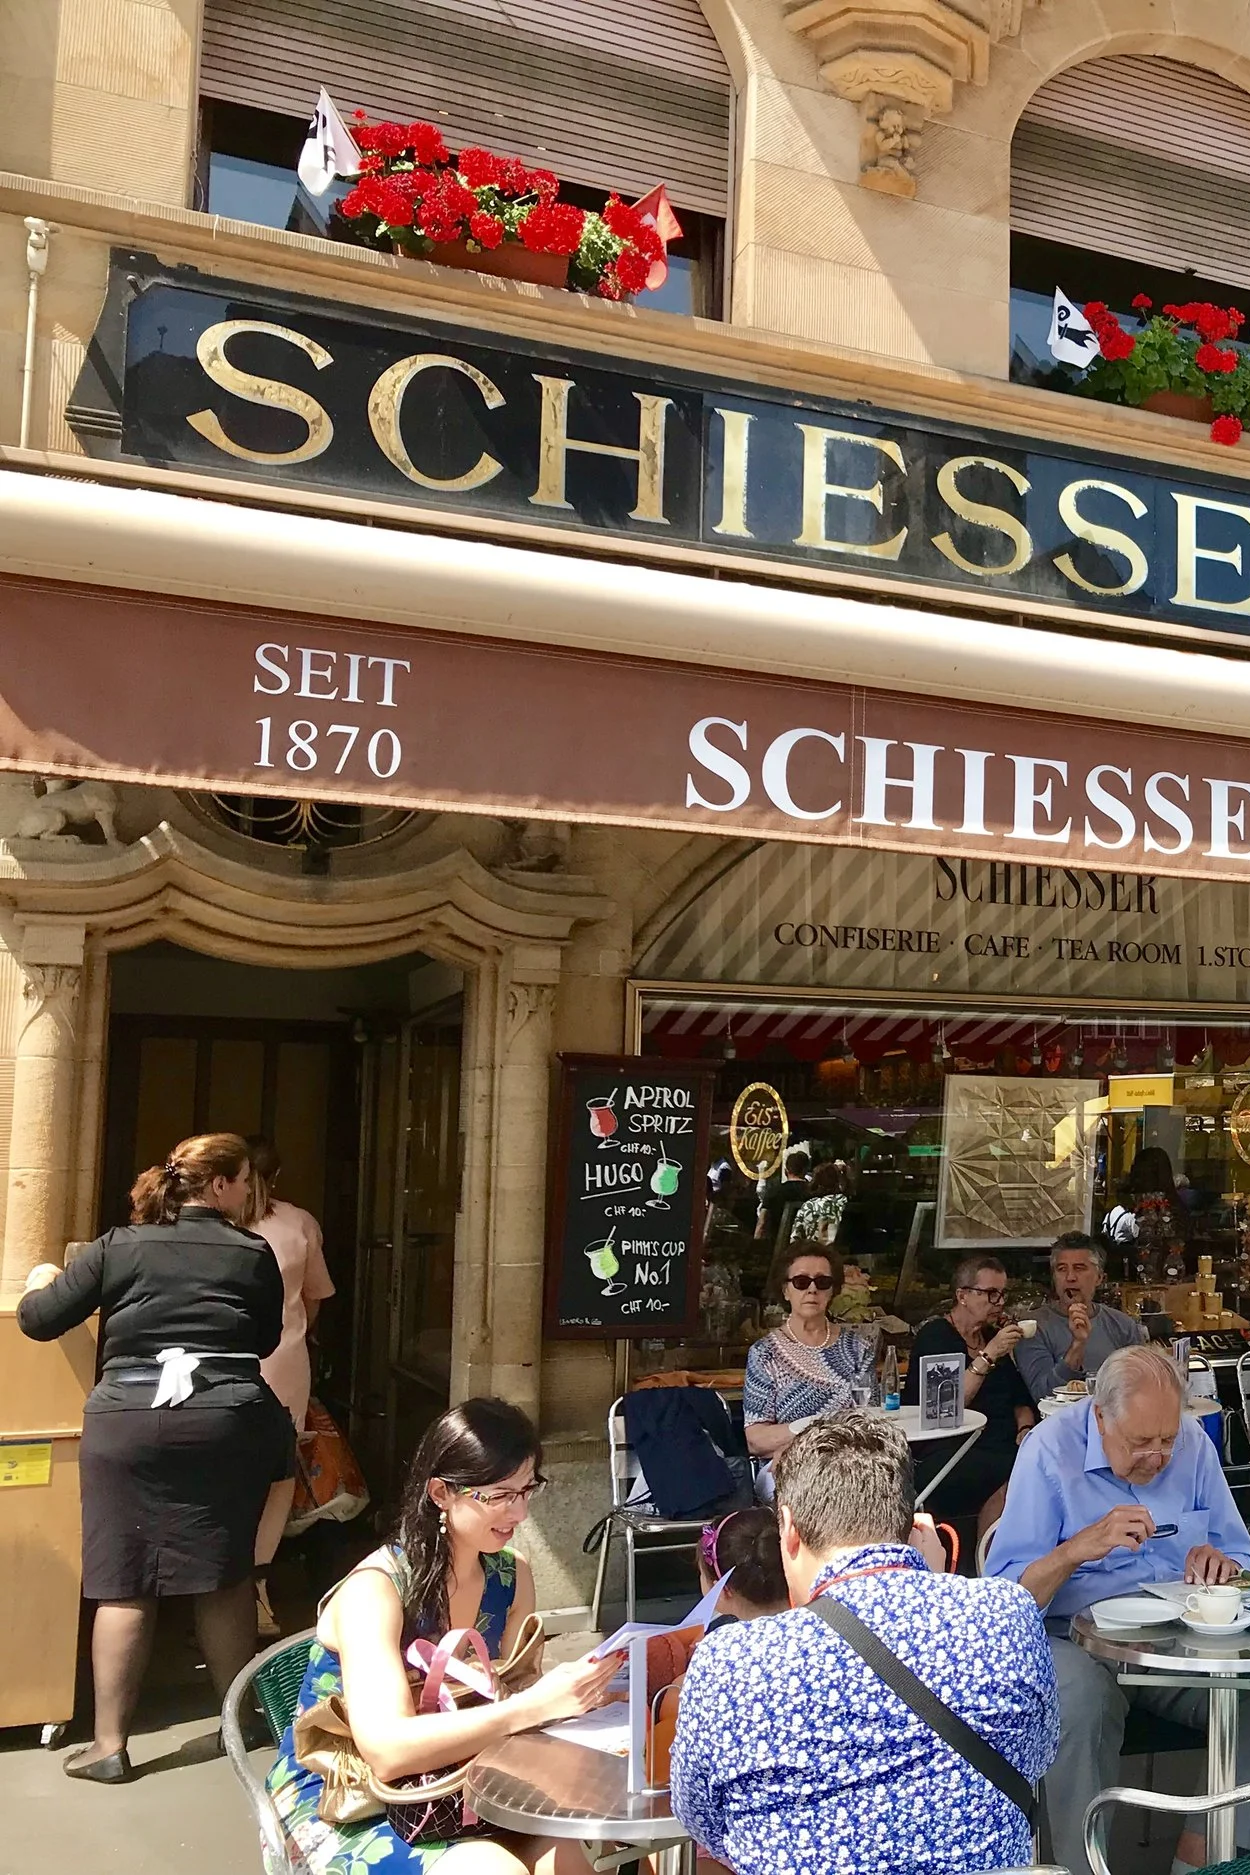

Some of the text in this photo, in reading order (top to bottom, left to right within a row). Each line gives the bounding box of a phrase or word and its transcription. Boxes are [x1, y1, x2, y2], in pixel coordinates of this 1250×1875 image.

[253, 642, 411, 708] SEIT
[253, 716, 403, 779] 1870
[773, 922, 941, 954] CONFISERIE
[964, 933, 1030, 959] CAFE
[1052, 937, 1101, 962] TEA
[1107, 941, 1182, 965] ROOM
[623, 1085, 695, 1110] APEROL
[628, 1113, 693, 1134] SPRITZ
[738, 1126, 782, 1160] Kaffee
[585, 1162, 643, 1191] HUGO
[604, 1205, 626, 1217] CHF
[661, 1241, 685, 1256] CUP
